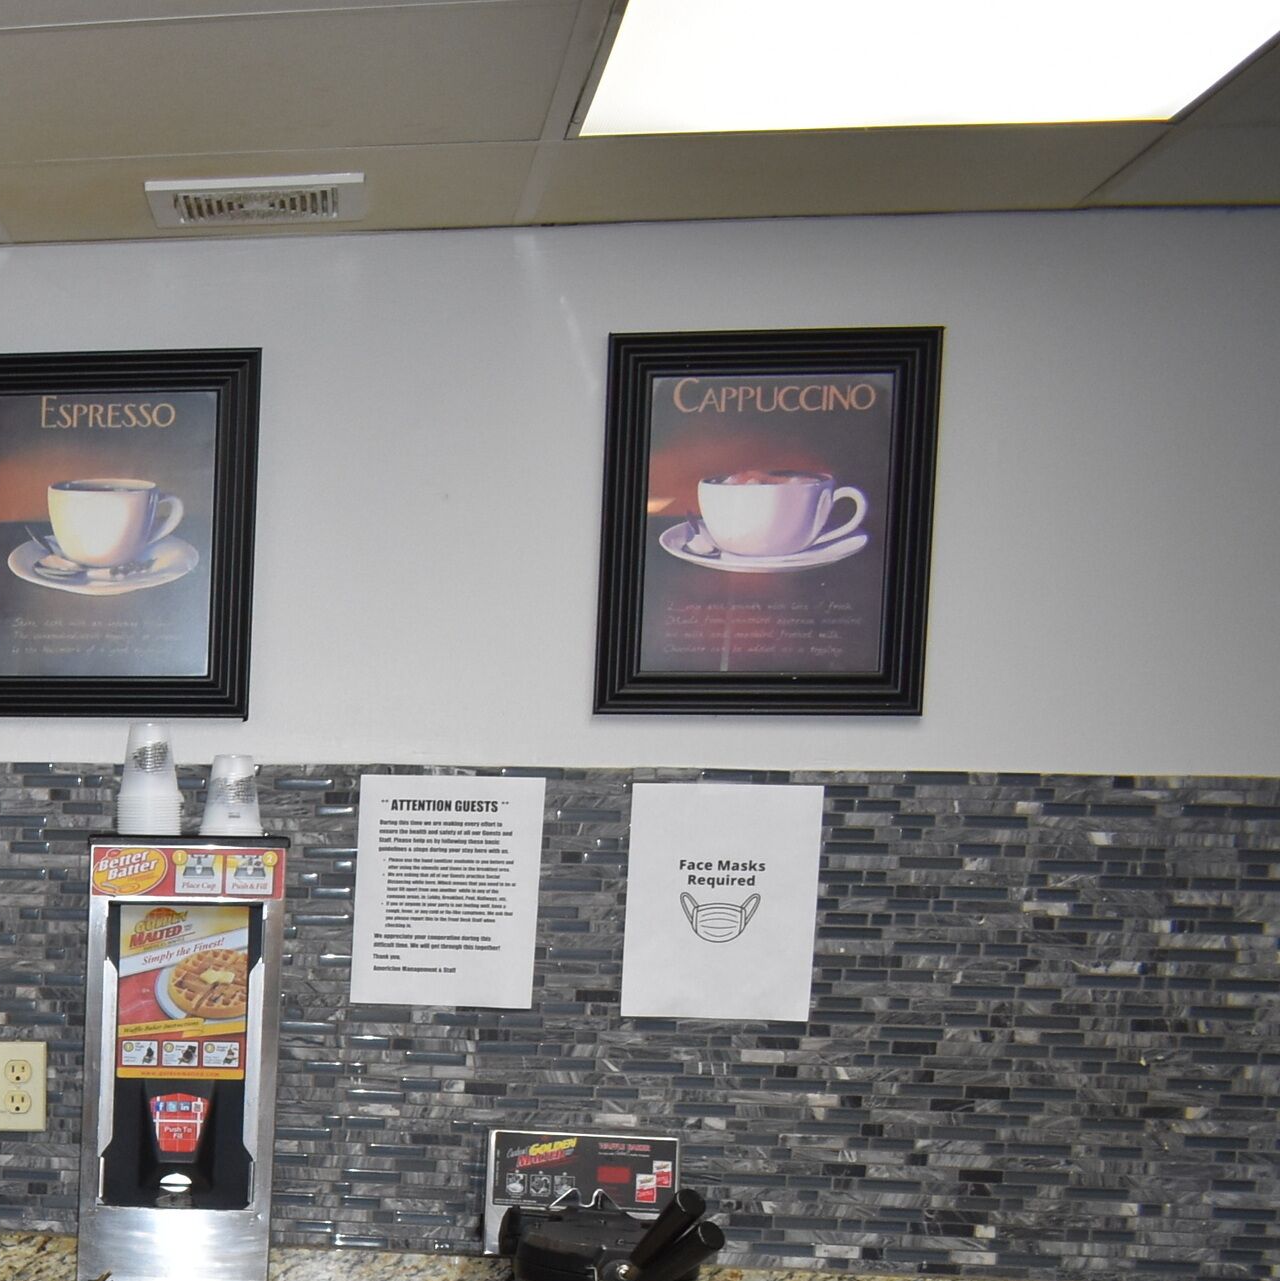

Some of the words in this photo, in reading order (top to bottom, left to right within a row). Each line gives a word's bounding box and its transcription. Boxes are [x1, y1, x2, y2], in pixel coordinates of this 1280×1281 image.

[674, 378, 876, 413] CAPPUCCINO
[41, 396, 176, 429] ESPRESSO
[391, 799, 452, 812] ATTENTION
[455, 800, 498, 813] GUESTS
[98, 852, 148, 872] Better
[108, 859, 157, 880] Batter
[679, 860, 712, 871] Face
[718, 860, 766, 871] Masks
[202, 882, 216, 891] Cup
[687, 875, 755, 888] Required
[129, 924, 182, 948] MALTED
[142, 951, 174, 965] Simply
[176, 947, 191, 956] the
[194, 937, 224, 952] Finest!
[529, 1138, 577, 1156] GOLDEN
